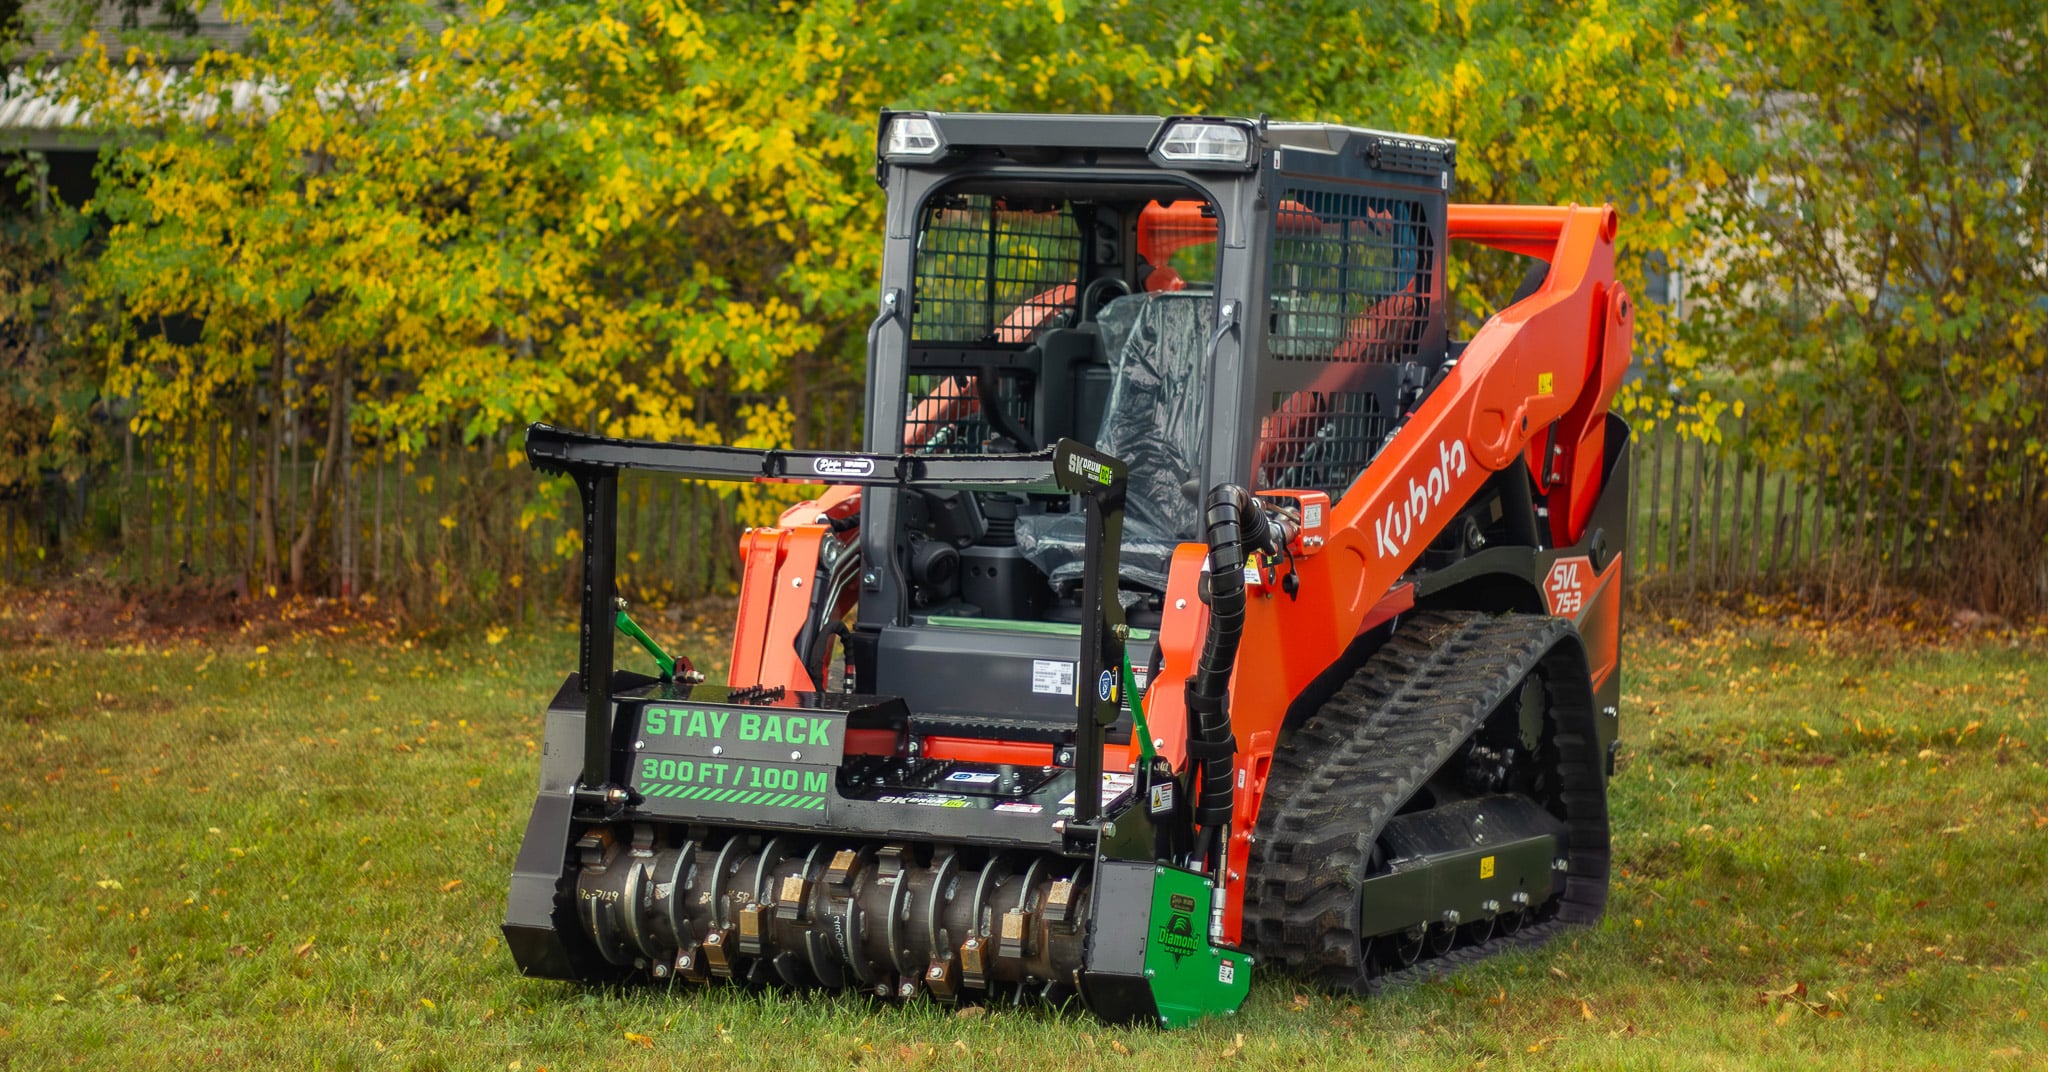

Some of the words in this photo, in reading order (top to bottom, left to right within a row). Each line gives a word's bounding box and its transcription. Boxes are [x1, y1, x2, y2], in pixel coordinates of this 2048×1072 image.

[1375, 439, 1467, 559] Kubota
[1551, 563, 1582, 592] SVL
[1556, 591, 1582, 615] 75-3
[646, 708, 730, 739] STAY
[739, 713, 832, 746] BACK
[642, 758, 694, 782] 300
[698, 763, 729, 785] FT
[732, 765, 745, 786] /
[750, 766, 799, 791] 100
[803, 771, 828, 793] M
[1158, 927, 1200, 951] Diamond
